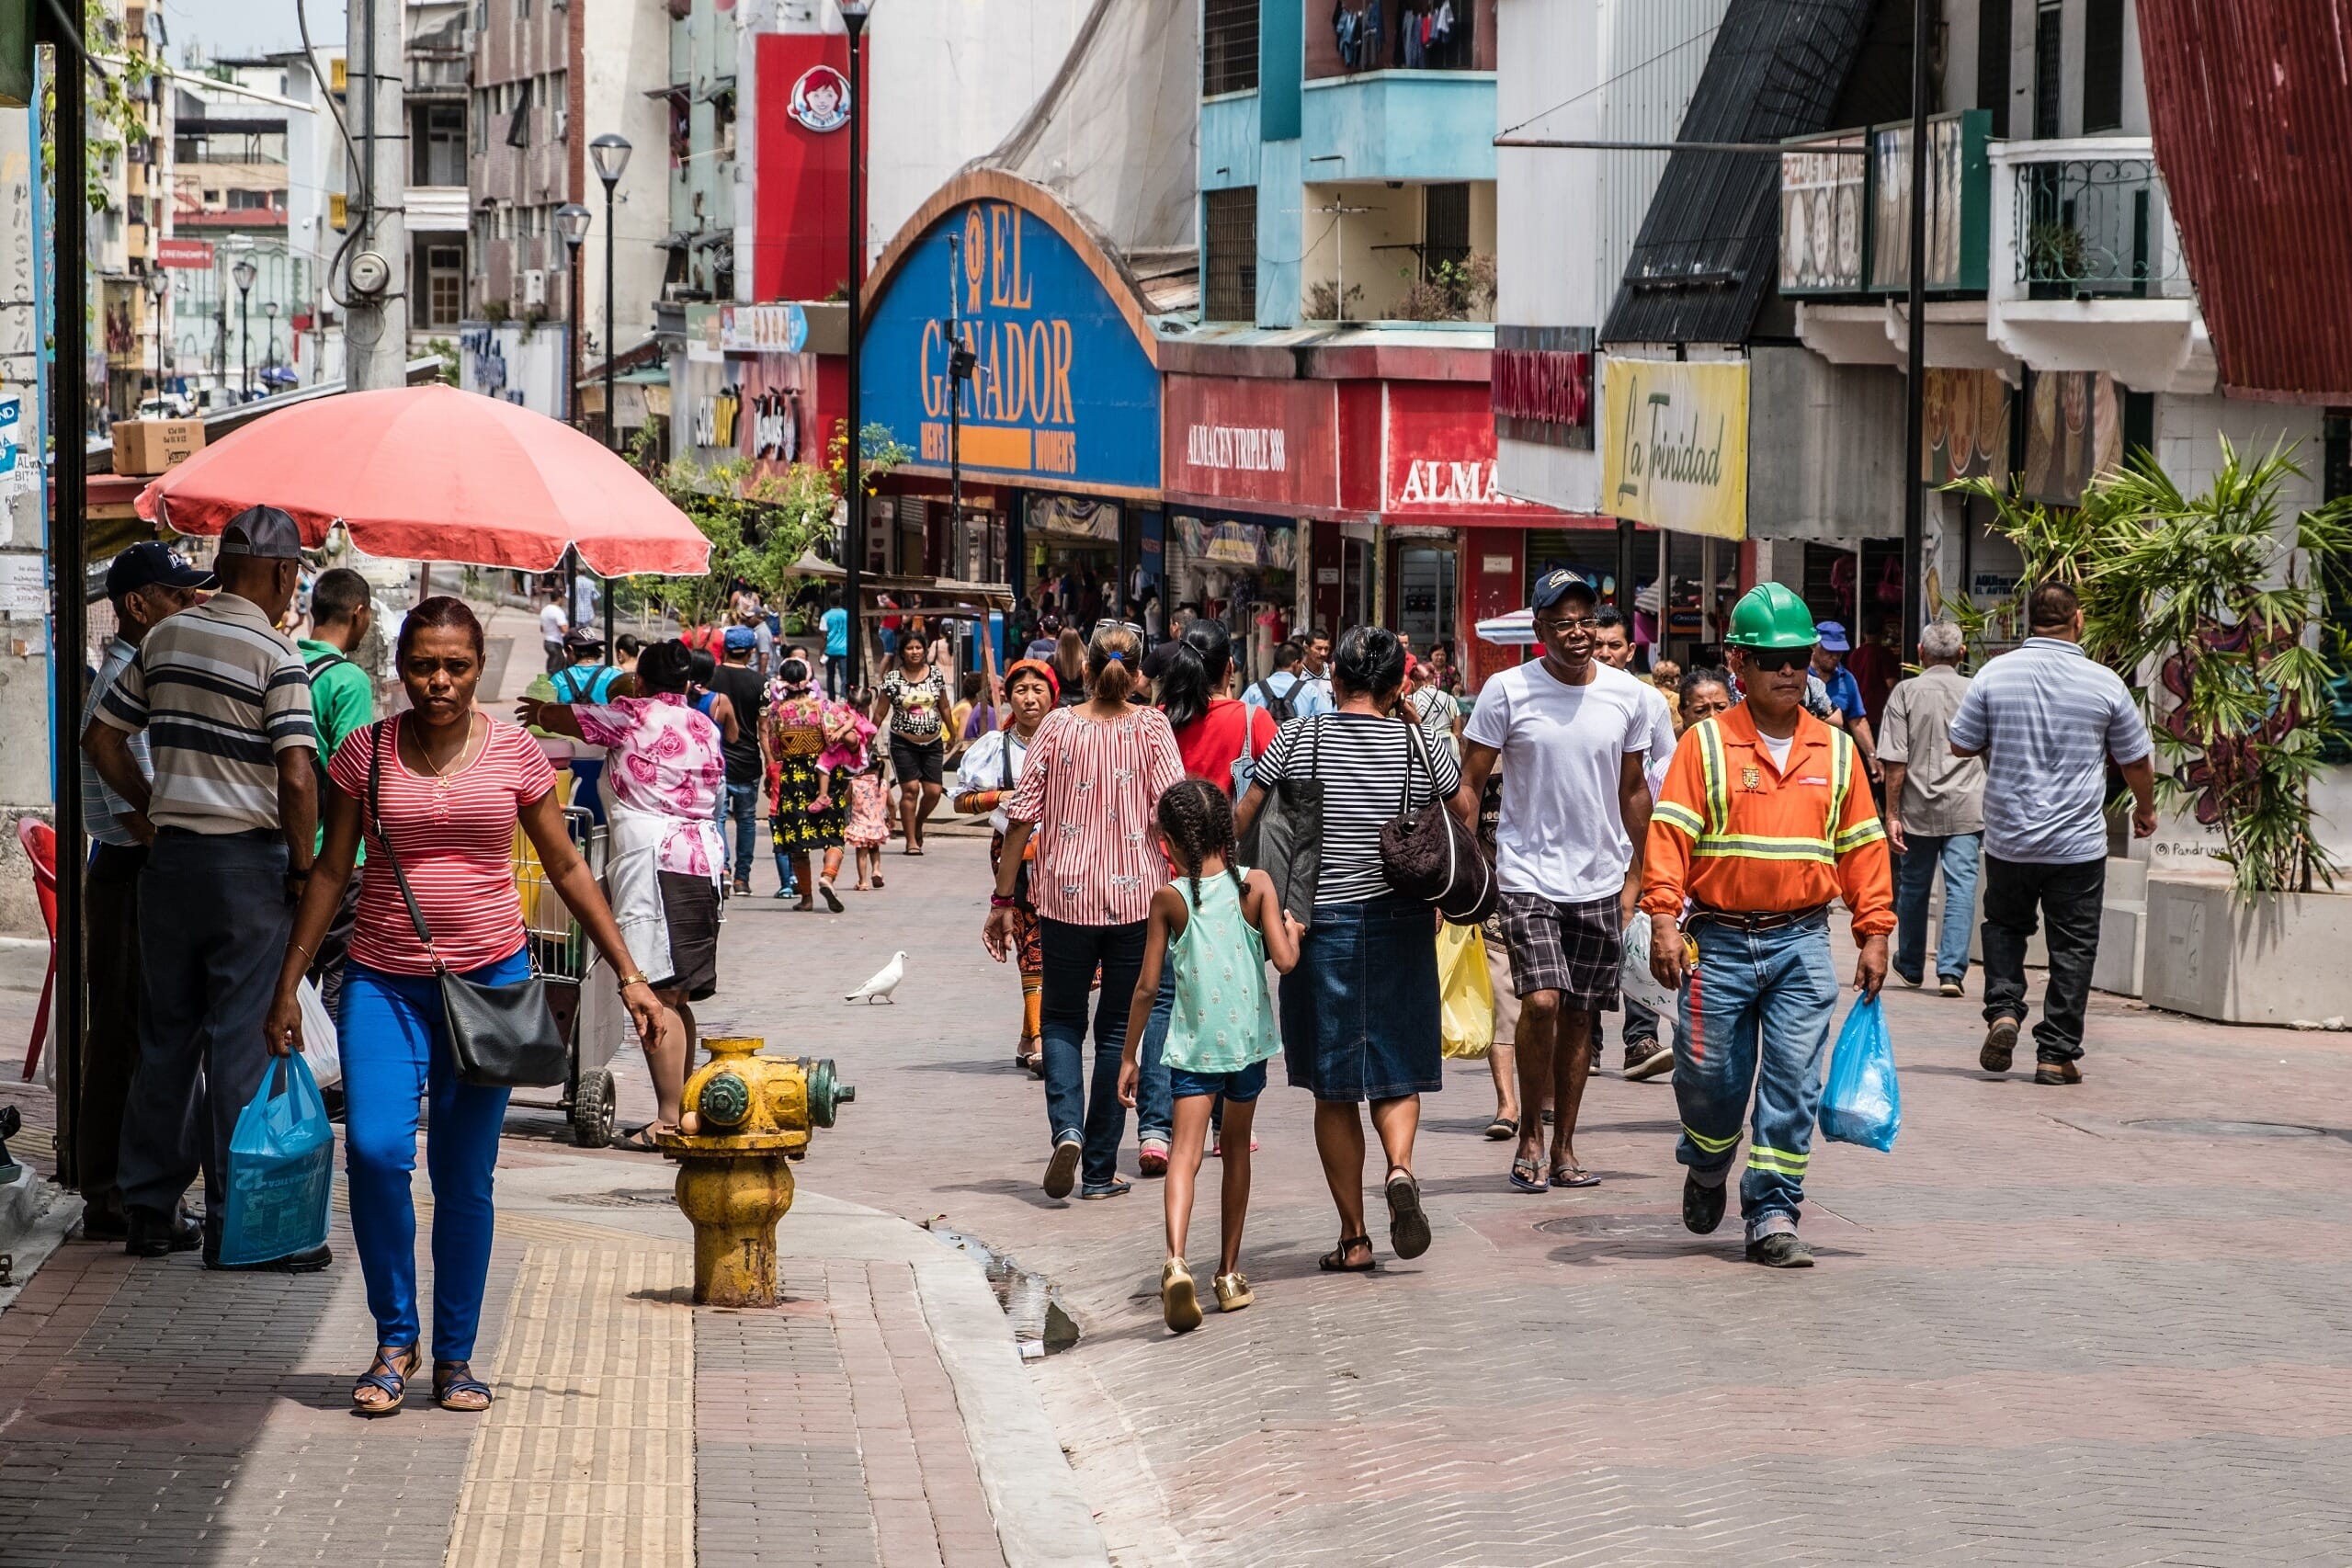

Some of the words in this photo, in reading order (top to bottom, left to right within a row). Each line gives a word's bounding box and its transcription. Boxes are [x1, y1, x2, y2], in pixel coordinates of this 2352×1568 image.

[990, 204, 1032, 309] EL
[696, 395, 738, 447] SUBWAY
[1618, 375, 1644, 506] La
[1648, 392, 1724, 505] Trinidad
[1187, 425, 1233, 469] ALMACEN
[1233, 427, 1268, 471] TRIPLE
[1269, 427, 1285, 472] 888
[1400, 459, 1527, 506] ALMA
[1642, 994, 1671, 1006] S.A.
